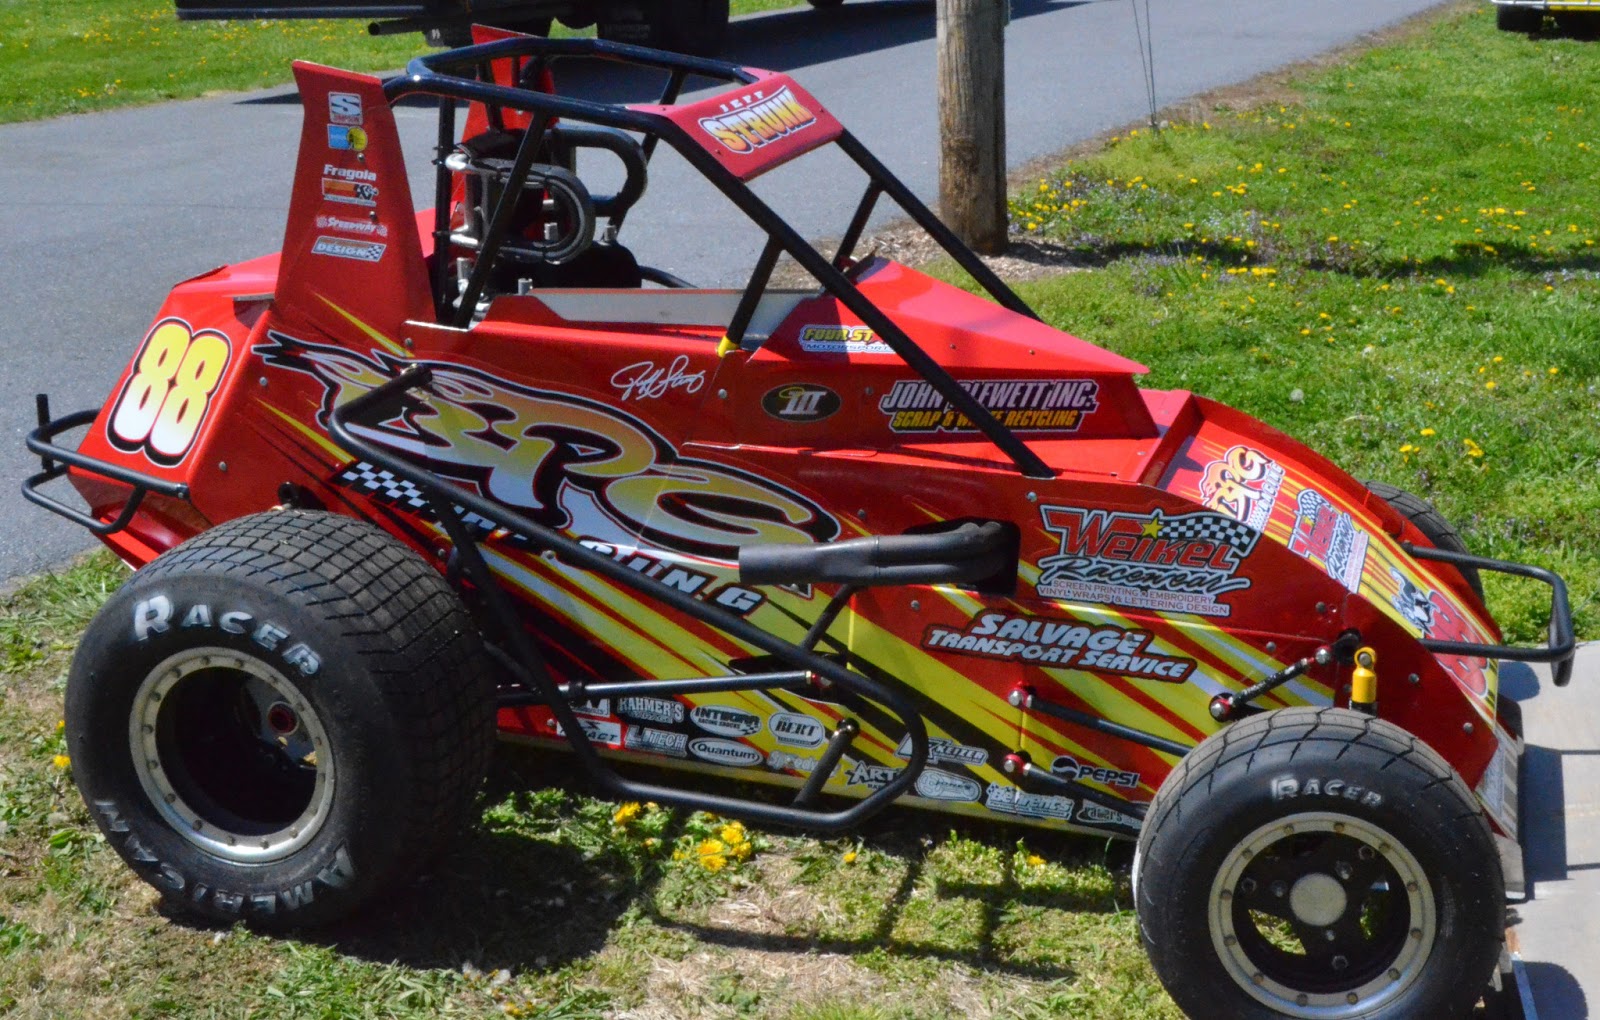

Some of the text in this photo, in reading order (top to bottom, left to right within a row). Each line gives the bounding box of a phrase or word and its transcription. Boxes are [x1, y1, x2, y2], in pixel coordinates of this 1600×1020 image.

[323, 164, 377, 182] Fragola
[315, 242, 368, 257] DESIGN
[803, 328, 849, 342] FOUR
[106, 317, 232, 468] 88
[882, 381, 944, 409] JOHN
[891, 410, 941, 428] SCRAP
[1004, 409, 1079, 427] RECYCLING
[1046, 509, 1234, 571] Weikel
[1039, 555, 1251, 593] Racewear
[1039, 586, 1228, 615] VINYL WRAPS & LETTERING DESIGN
[1052, 580, 1213, 605] SCREEN PRINTING EMBROIDERY
[134, 594, 322, 677] RACER
[971, 613, 1147, 656] SALVAGE
[927, 629, 1190, 678] TRANSPORT SERVICE
[697, 743, 757, 760] Quantum
[935, 745, 985, 760] KEIZER
[1078, 766, 1140, 787] PEPSI
[1270, 776, 1383, 807] RACER
